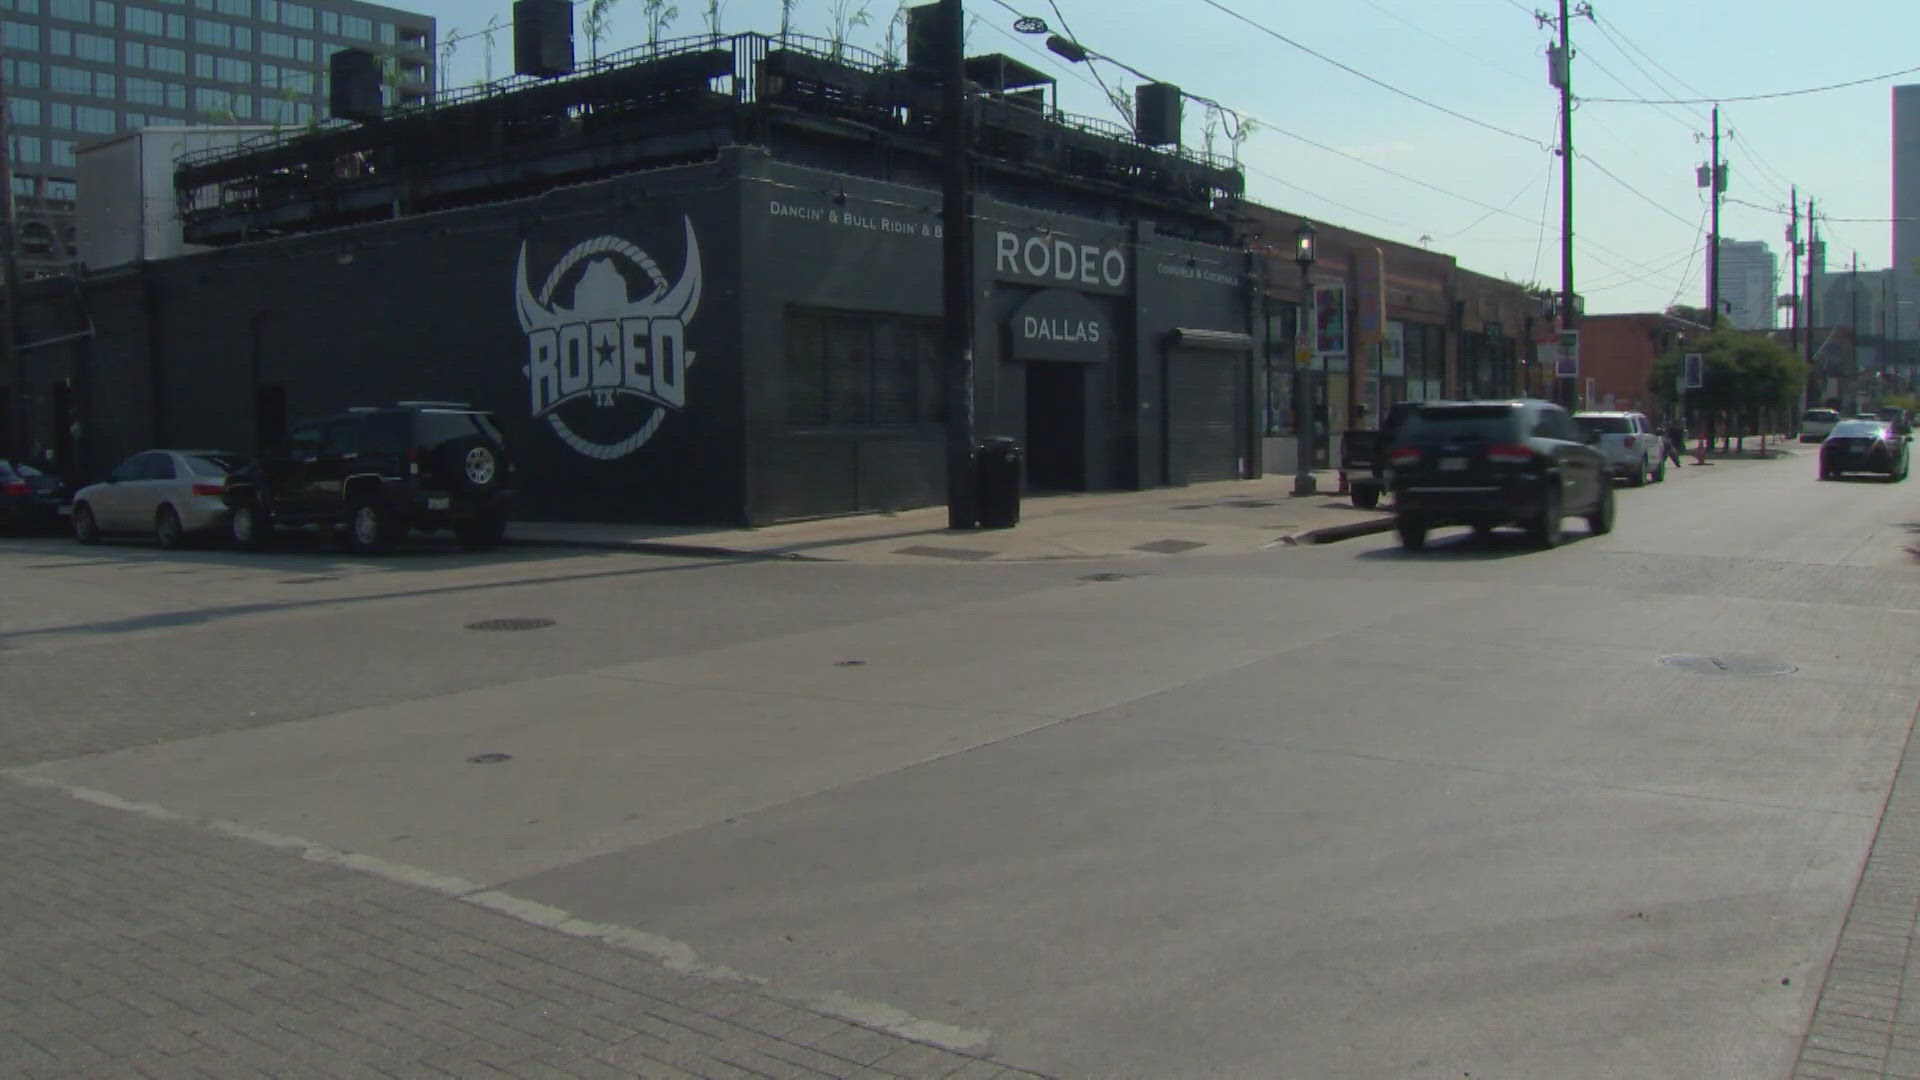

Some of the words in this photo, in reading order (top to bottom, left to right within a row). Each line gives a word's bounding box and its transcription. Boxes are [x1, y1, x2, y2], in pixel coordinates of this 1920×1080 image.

[828, 210, 838, 224] &
[844, 213, 877, 230] BULL
[922, 224, 930, 236] &
[996, 231, 1125, 287] RODEO
[1024, 316, 1099, 342] DALLAS
[529, 317, 685, 417] RODEO
